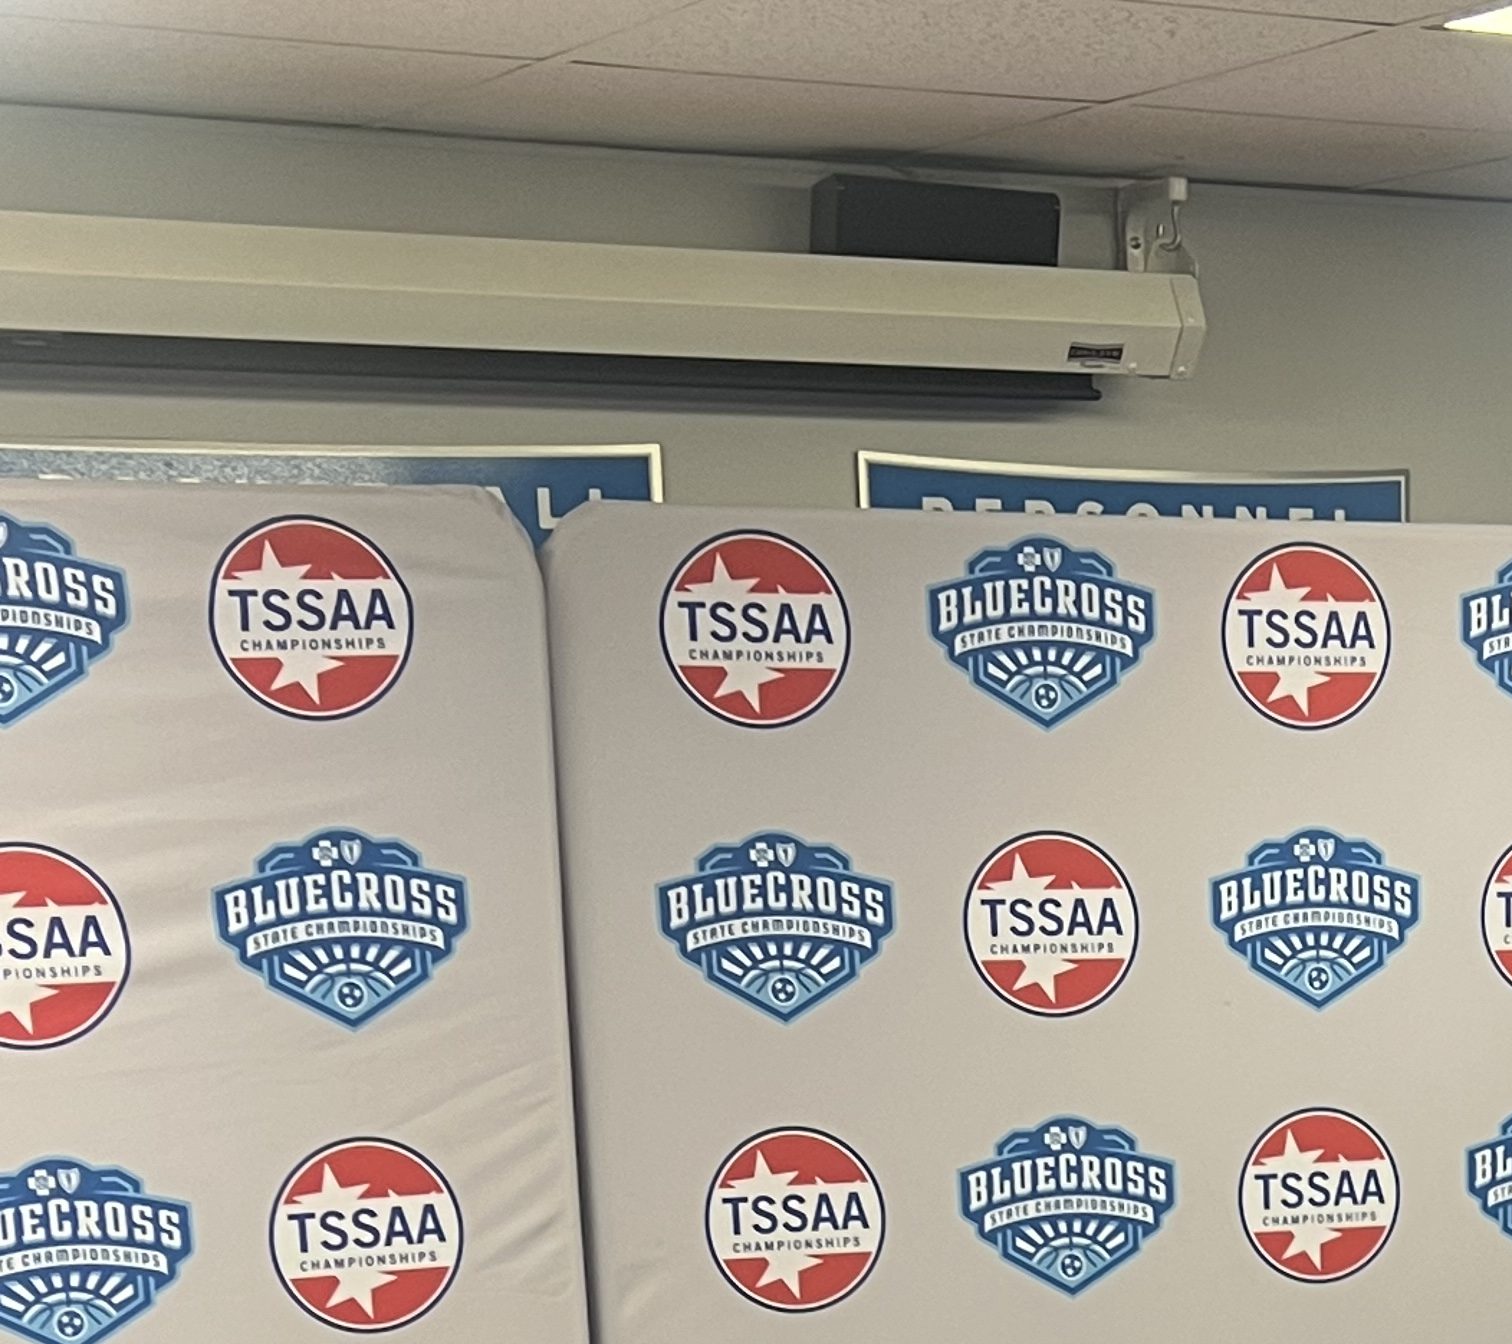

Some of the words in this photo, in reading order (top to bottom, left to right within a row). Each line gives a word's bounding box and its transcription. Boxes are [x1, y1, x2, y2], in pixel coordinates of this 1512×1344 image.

[227, 589, 395, 631] TSSAA
[937, 576, 1145, 634] BLUECROSS
[678, 601, 833, 644] TSSAA
[961, 629, 1001, 648] STATE
[1008, 623, 1126, 650] CHAMPIONSHIPS
[1238, 610, 1375, 649] TSSAA
[241, 638, 386, 651] CHAMPIONSHIPS
[689, 650, 824, 663] CHAMPIONSHIPS
[1246, 656, 1367, 667] CHAMPIONSHIPS
[225, 870, 457, 935] BLUECROSS
[667, 871, 884, 930] BLUECROSS
[1219, 865, 1411, 921] BLUECROSS
[693, 925, 735, 944] STATE
[742, 918, 865, 943] CHAMPIONSHIPS
[981, 897, 1123, 937] TSSAA
[1241, 917, 1277, 935] STATE
[1284, 910, 1393, 933] CHAMPIONSHIPS
[254, 928, 298, 950] STATE
[305, 920, 437, 942] CHAMPIONSHIPS
[990, 943, 1114, 955] CHAMPIONSHIPS
[968, 1153, 1165, 1212] BLUECROSS
[1255, 1169, 1385, 1209] TSSAA
[722, 1192, 869, 1235] TSSAA
[991, 1205, 1029, 1225] STATE
[1035, 1198, 1148, 1218] CHAMPIONSHIPS
[1262, 1211, 1377, 1226] CHAMPIONSHIPS
[288, 1204, 446, 1253] TSSAA
[22, 1248, 160, 1268] CHAMPIONSHIPS
[733, 1237, 860, 1253] CHAMPIONSHIPS
[300, 1251, 437, 1272] CHAMPIONSHIPS
